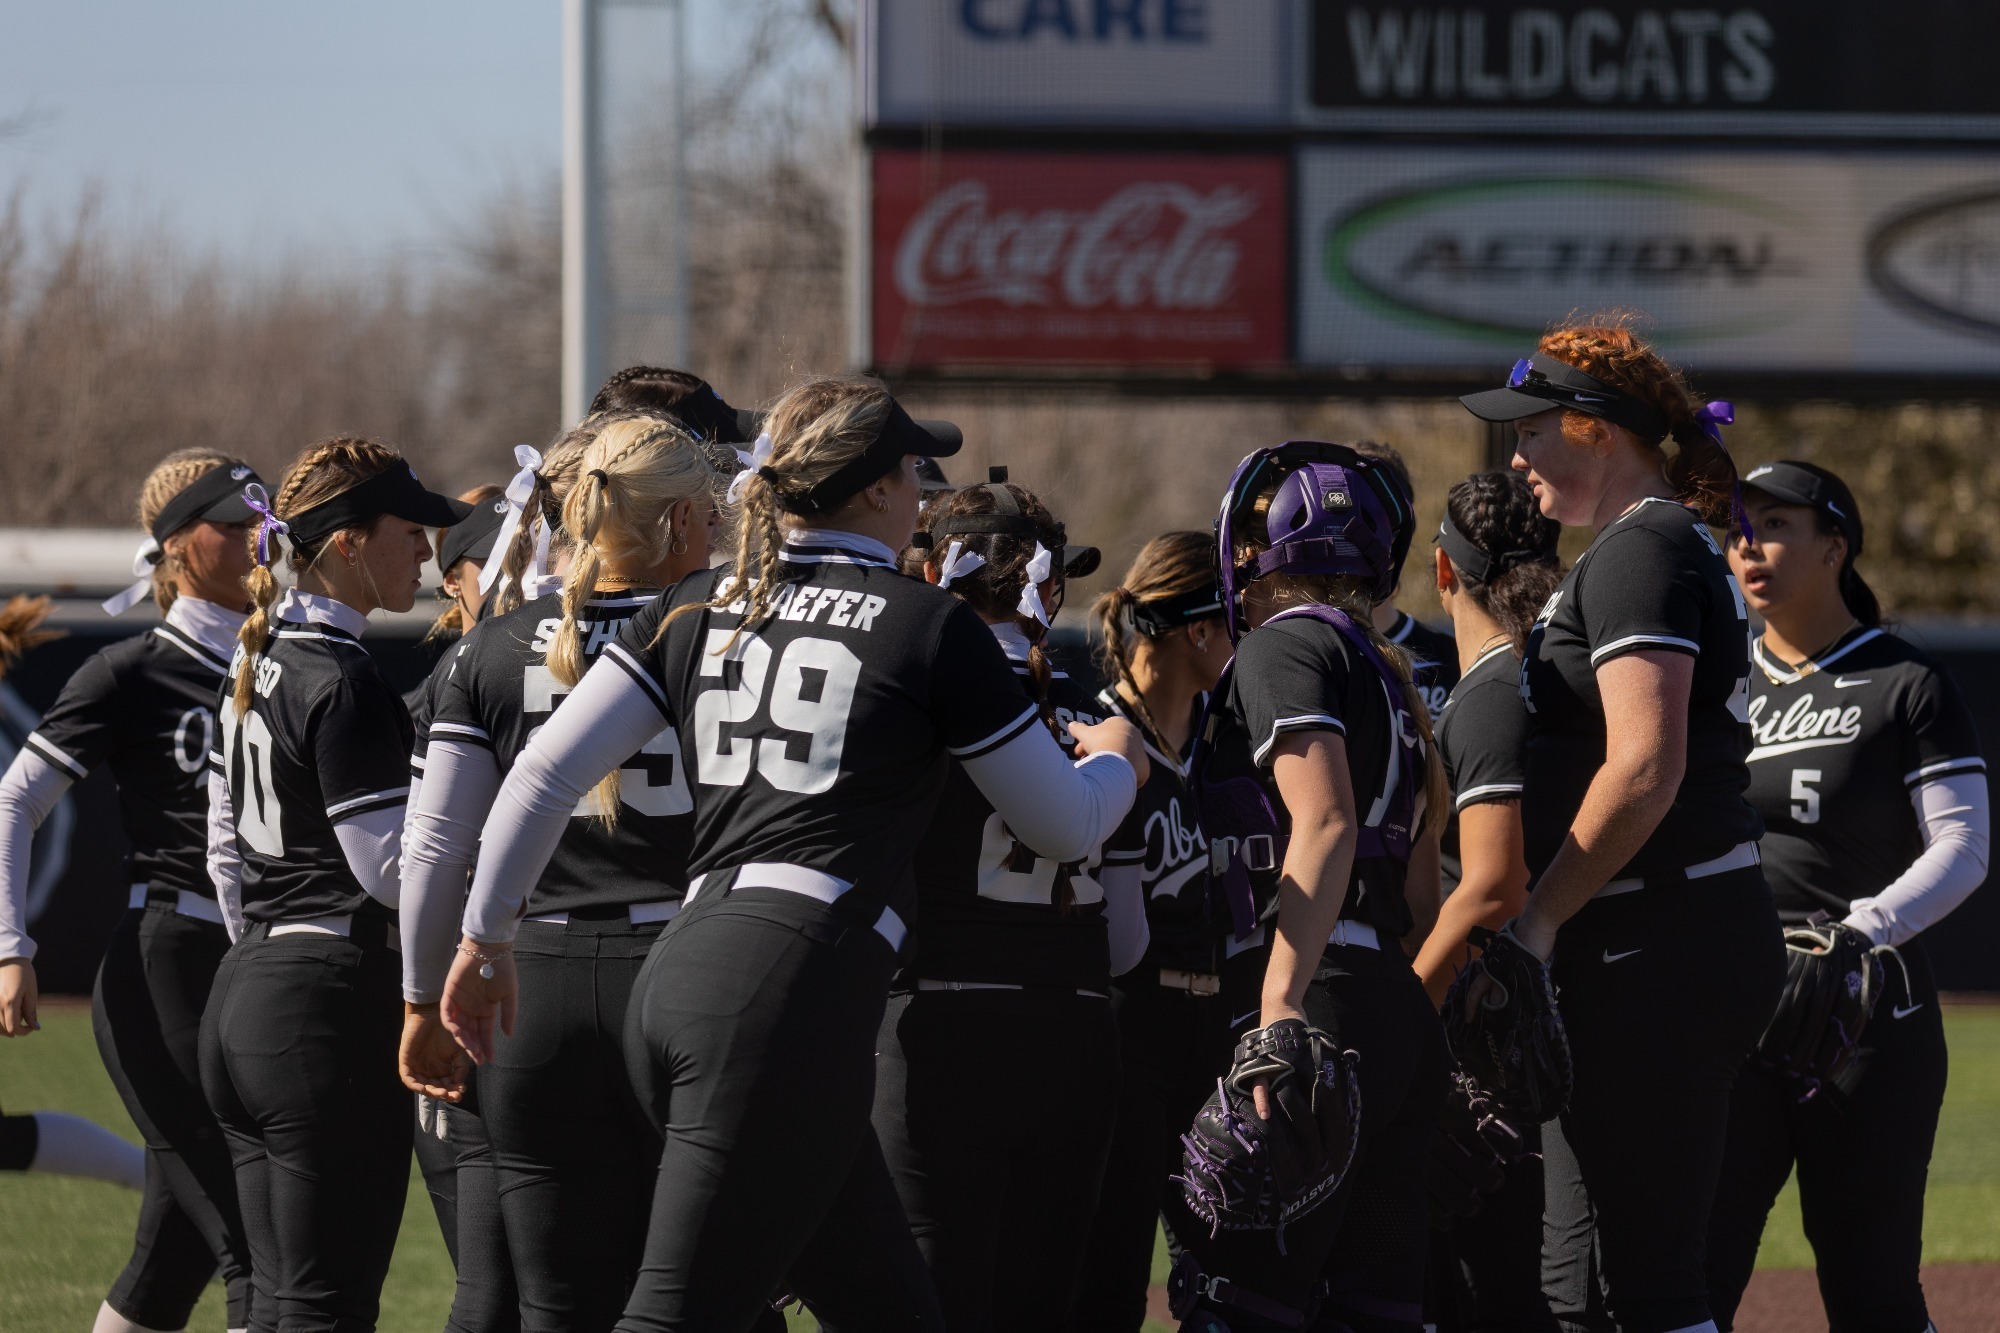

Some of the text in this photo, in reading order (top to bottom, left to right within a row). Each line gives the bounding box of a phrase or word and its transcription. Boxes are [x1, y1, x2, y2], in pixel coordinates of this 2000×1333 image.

[959, 0, 1208, 41] CARE
[1346, 8, 1774, 102] WILDCATS
[695, 628, 862, 795] 29
[1790, 768, 1822, 825] 5
